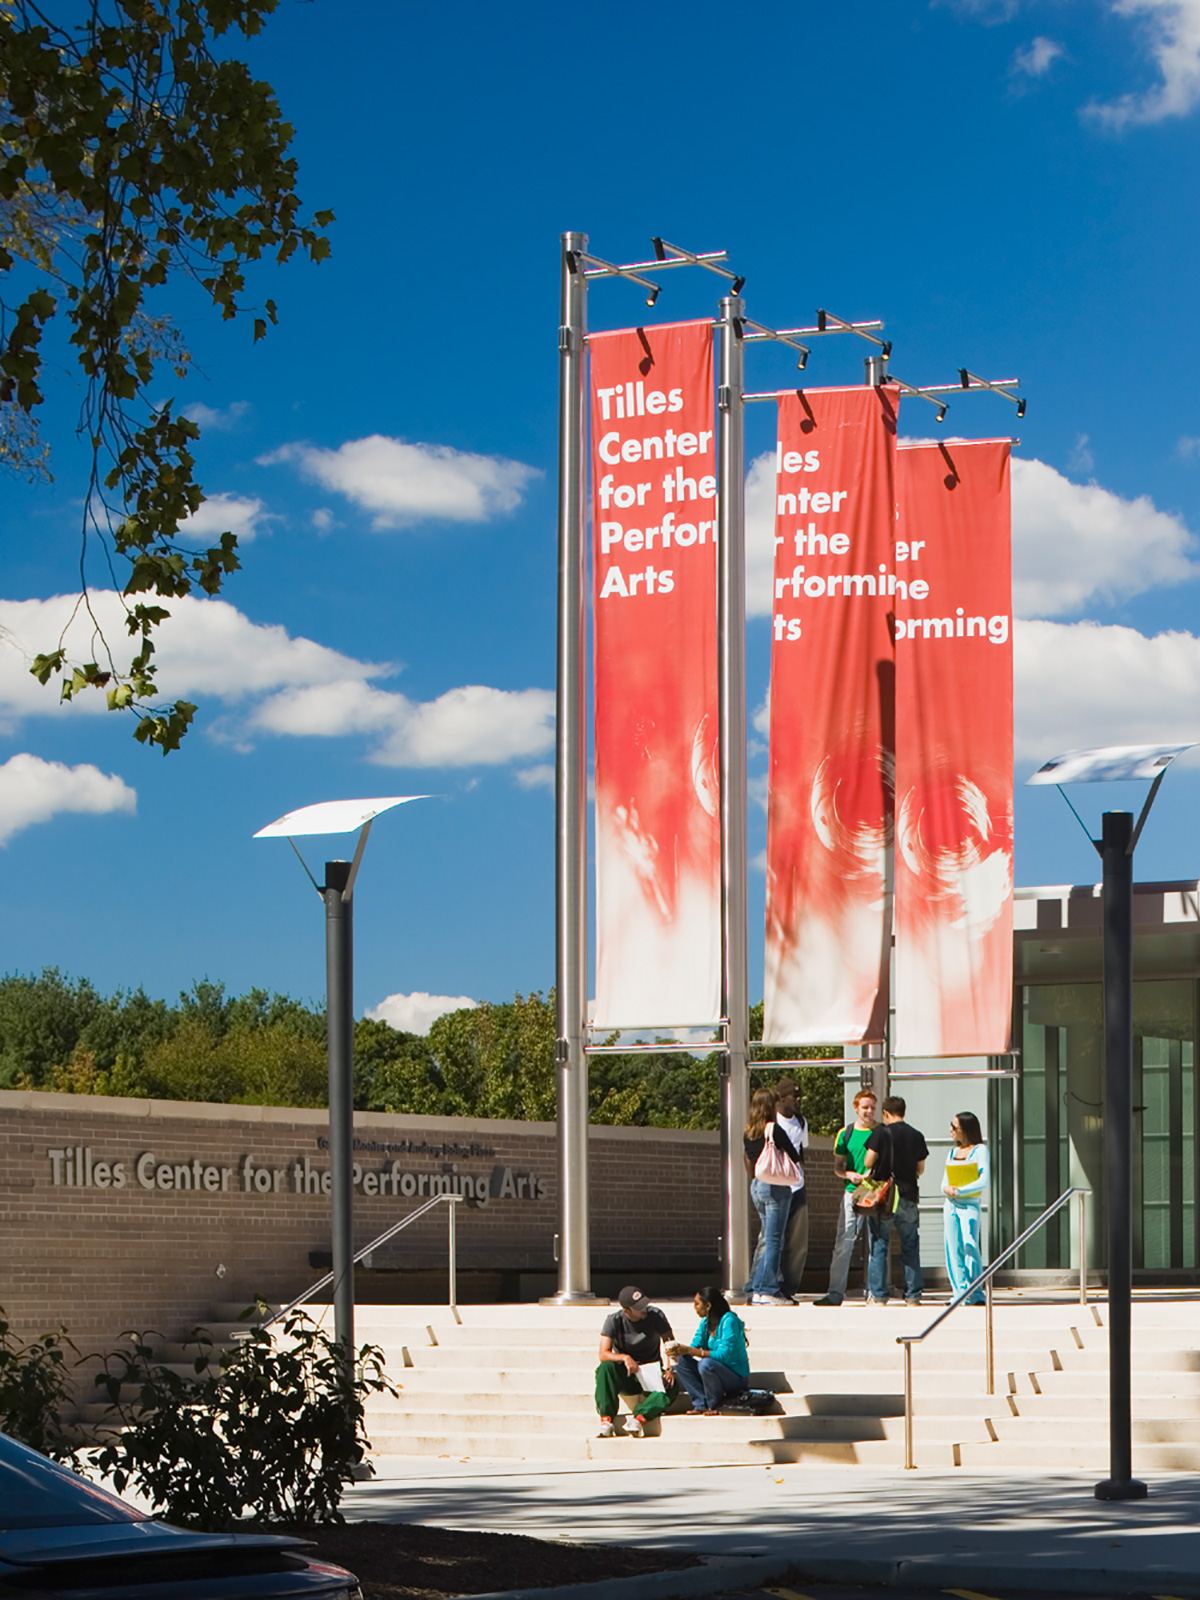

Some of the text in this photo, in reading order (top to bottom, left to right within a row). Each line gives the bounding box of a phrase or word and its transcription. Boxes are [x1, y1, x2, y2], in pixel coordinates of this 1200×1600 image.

[597, 381, 684, 421] Tilles
[598, 429, 713, 465] Center
[598, 466, 717, 510] for the
[777, 487, 848, 516] nter
[600, 512, 719, 554] Perfor
[794, 522, 850, 556] the
[599, 565, 675, 599] Arts
[48, 1147, 126, 1189] Tilles
[136, 1152, 232, 1191] Center
[243, 1155, 285, 1193] for
[293, 1157, 332, 1195] the
[500, 1166, 548, 1199] Arts
